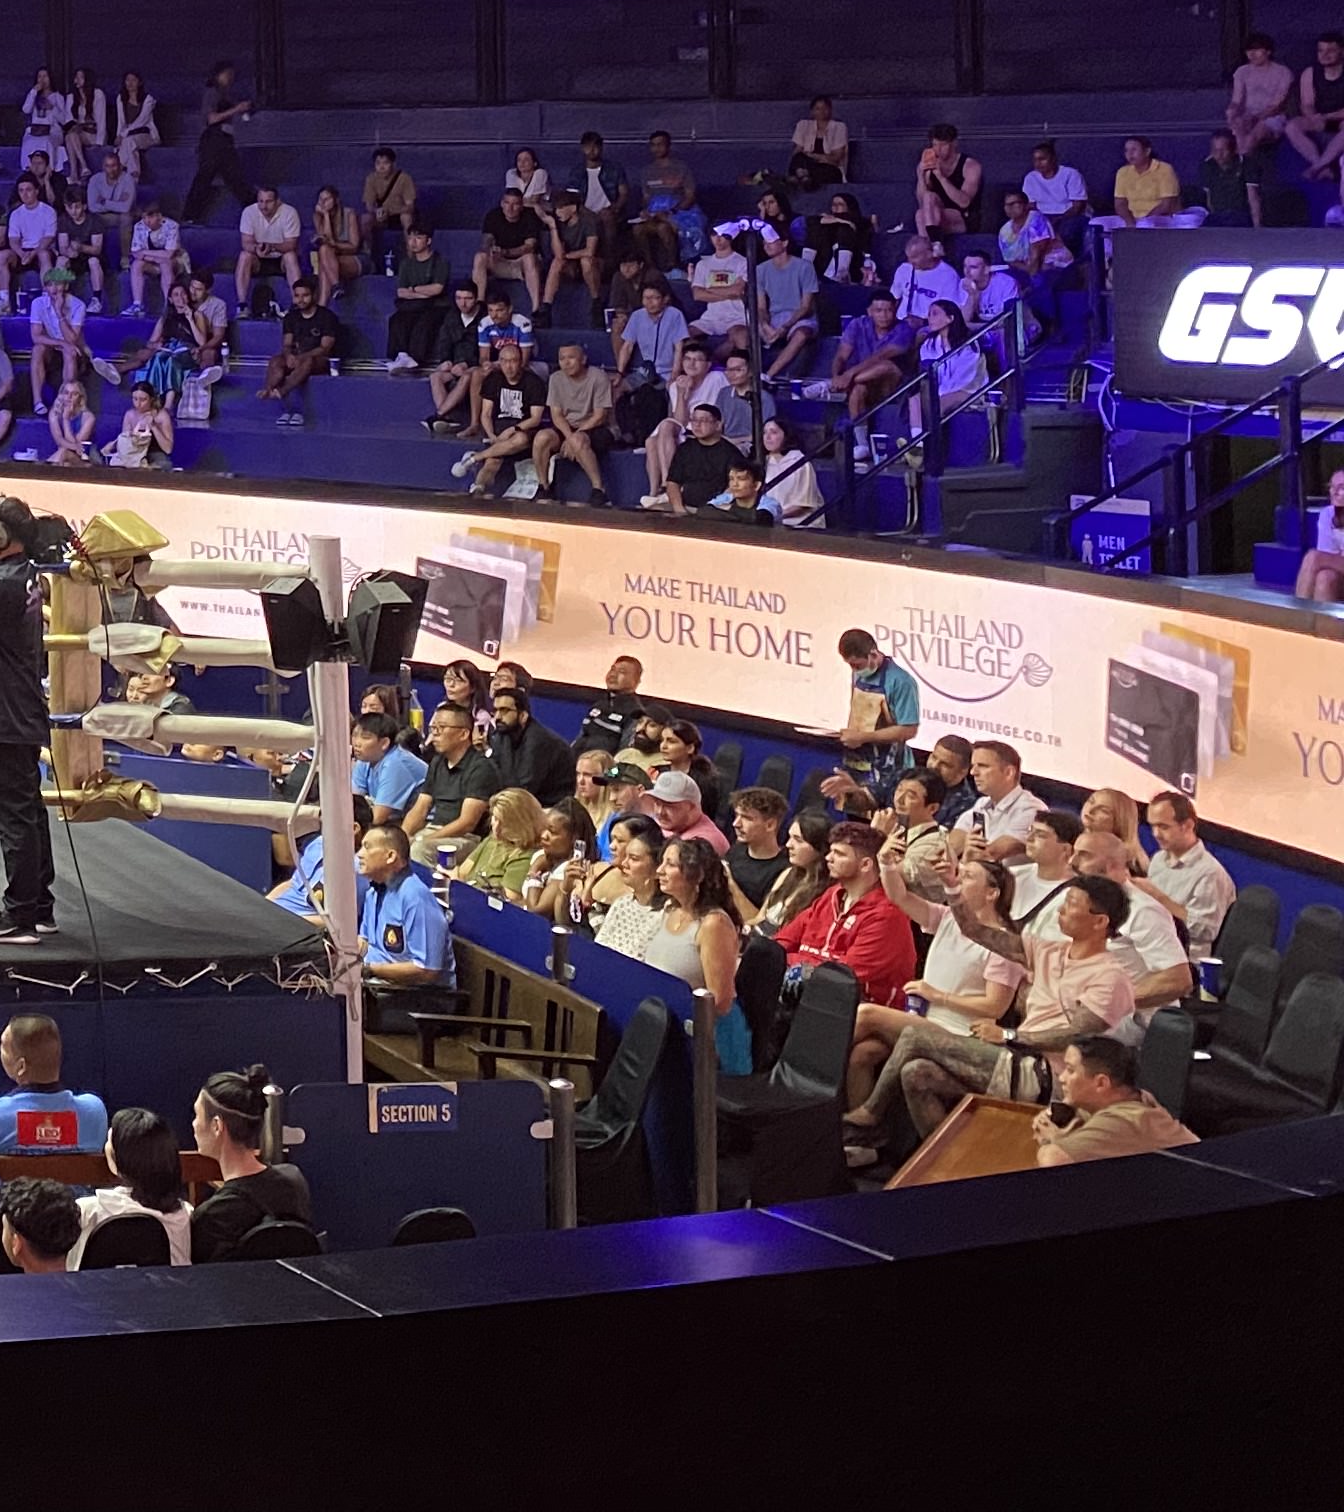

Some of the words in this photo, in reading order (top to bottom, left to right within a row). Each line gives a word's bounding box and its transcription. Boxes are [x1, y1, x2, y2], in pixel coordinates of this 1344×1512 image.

[217, 525, 310, 553] THAILAN
[1098, 534, 1126, 551] MEN
[1099, 552, 1142, 571] TLET
[624, 573, 681, 600] MAKE
[686, 581, 787, 615] THAILAND
[600, 602, 700, 648] YOUR
[709, 617, 814, 668] HOME
[903, 606, 1024, 650] THAILAND
[874, 624, 1013, 680] PRIVILEGE
[921, 708, 1063, 748] ILANDPRIVILEGE.CO.TH
[381, 1104, 438, 1123] SECTION
[441, 1103, 452, 1122] 5
